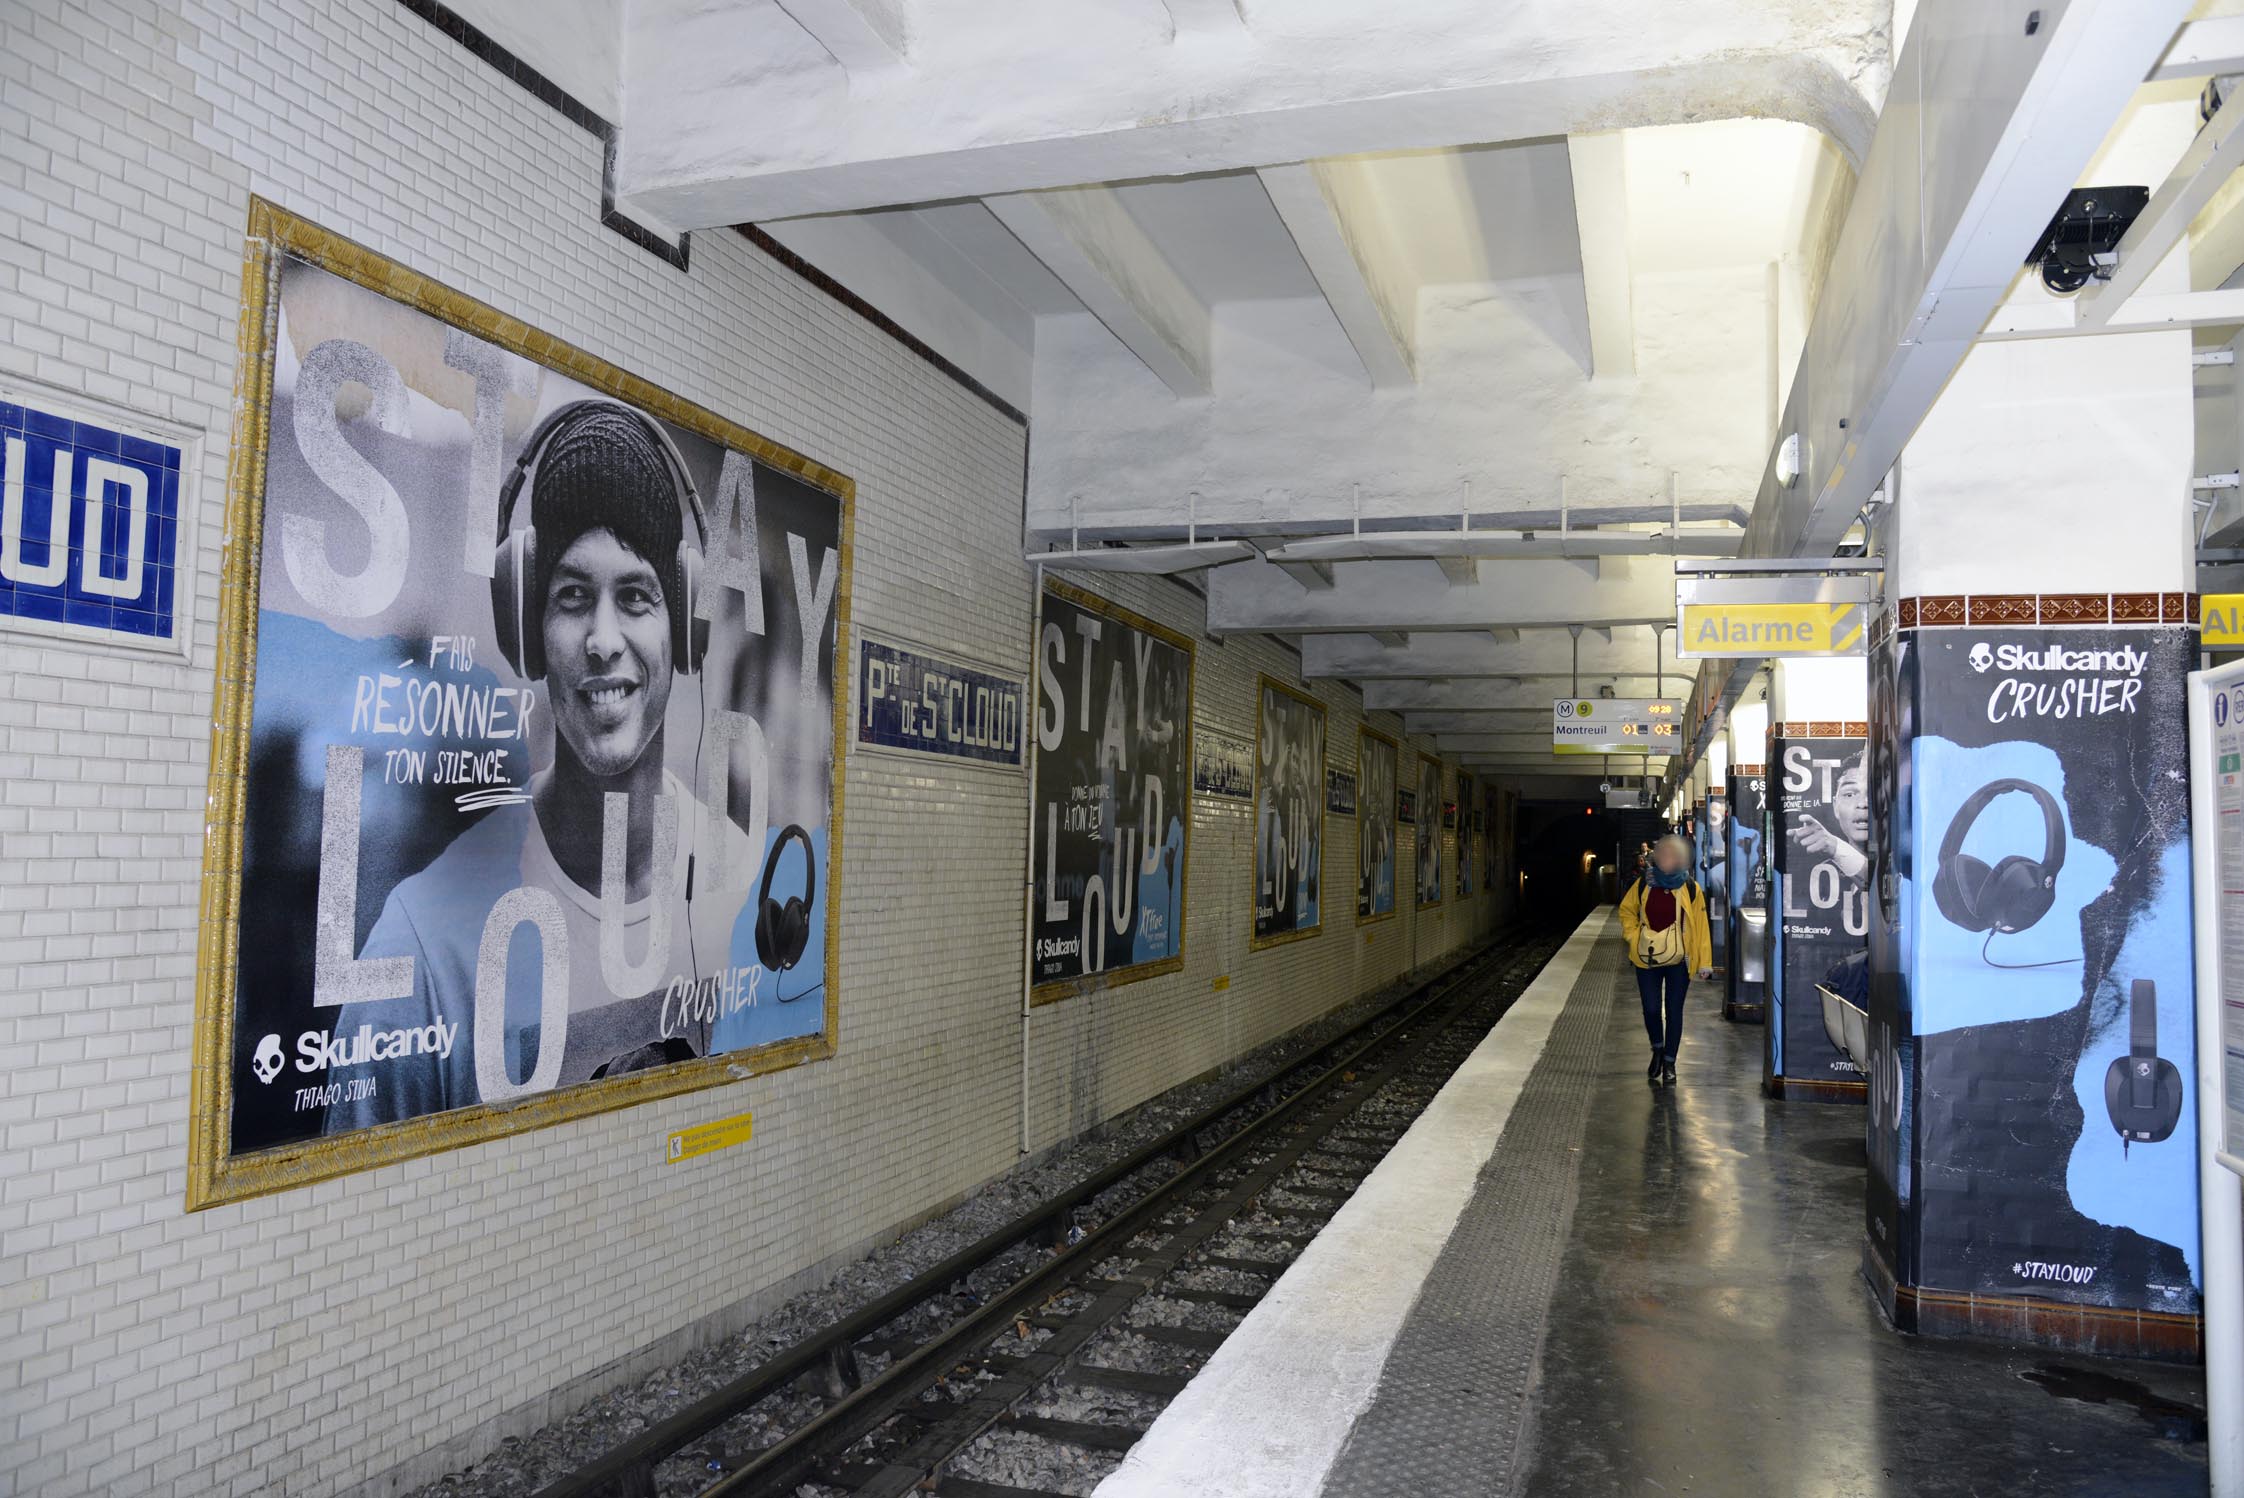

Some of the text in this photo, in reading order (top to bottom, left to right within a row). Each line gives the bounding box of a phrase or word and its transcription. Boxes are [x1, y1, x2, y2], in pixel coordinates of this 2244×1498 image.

[1697, 617, 1813, 643] Alarme
[2202, 607, 2244, 635] Al
[429, 636, 476, 672] FAIS
[1997, 645, 2148, 676] Skullcandy
[351, 659, 535, 740] RÉSONNER
[902, 700, 918, 736] DE
[948, 679, 1016, 751] CLOUD
[1580, 704, 1588, 714] 9
[1987, 678, 2142, 723] CRUSHER
[1556, 725, 1607, 735] Montreuil
[1654, 723, 1672, 736] 03
[385, 748, 511, 785] TON SILENCE.
[1071, 804, 1087, 832] TON
[1089, 801, 1103, 830] JEU
[1044, 935, 1080, 957] Skullcandy
[1791, 925, 1832, 936] Skullcandy
[660, 964, 762, 1039] CRUSHER
[295, 1015, 458, 1073] Skullcandy
[295, 1076, 377, 1112] THIAGO SILVA
